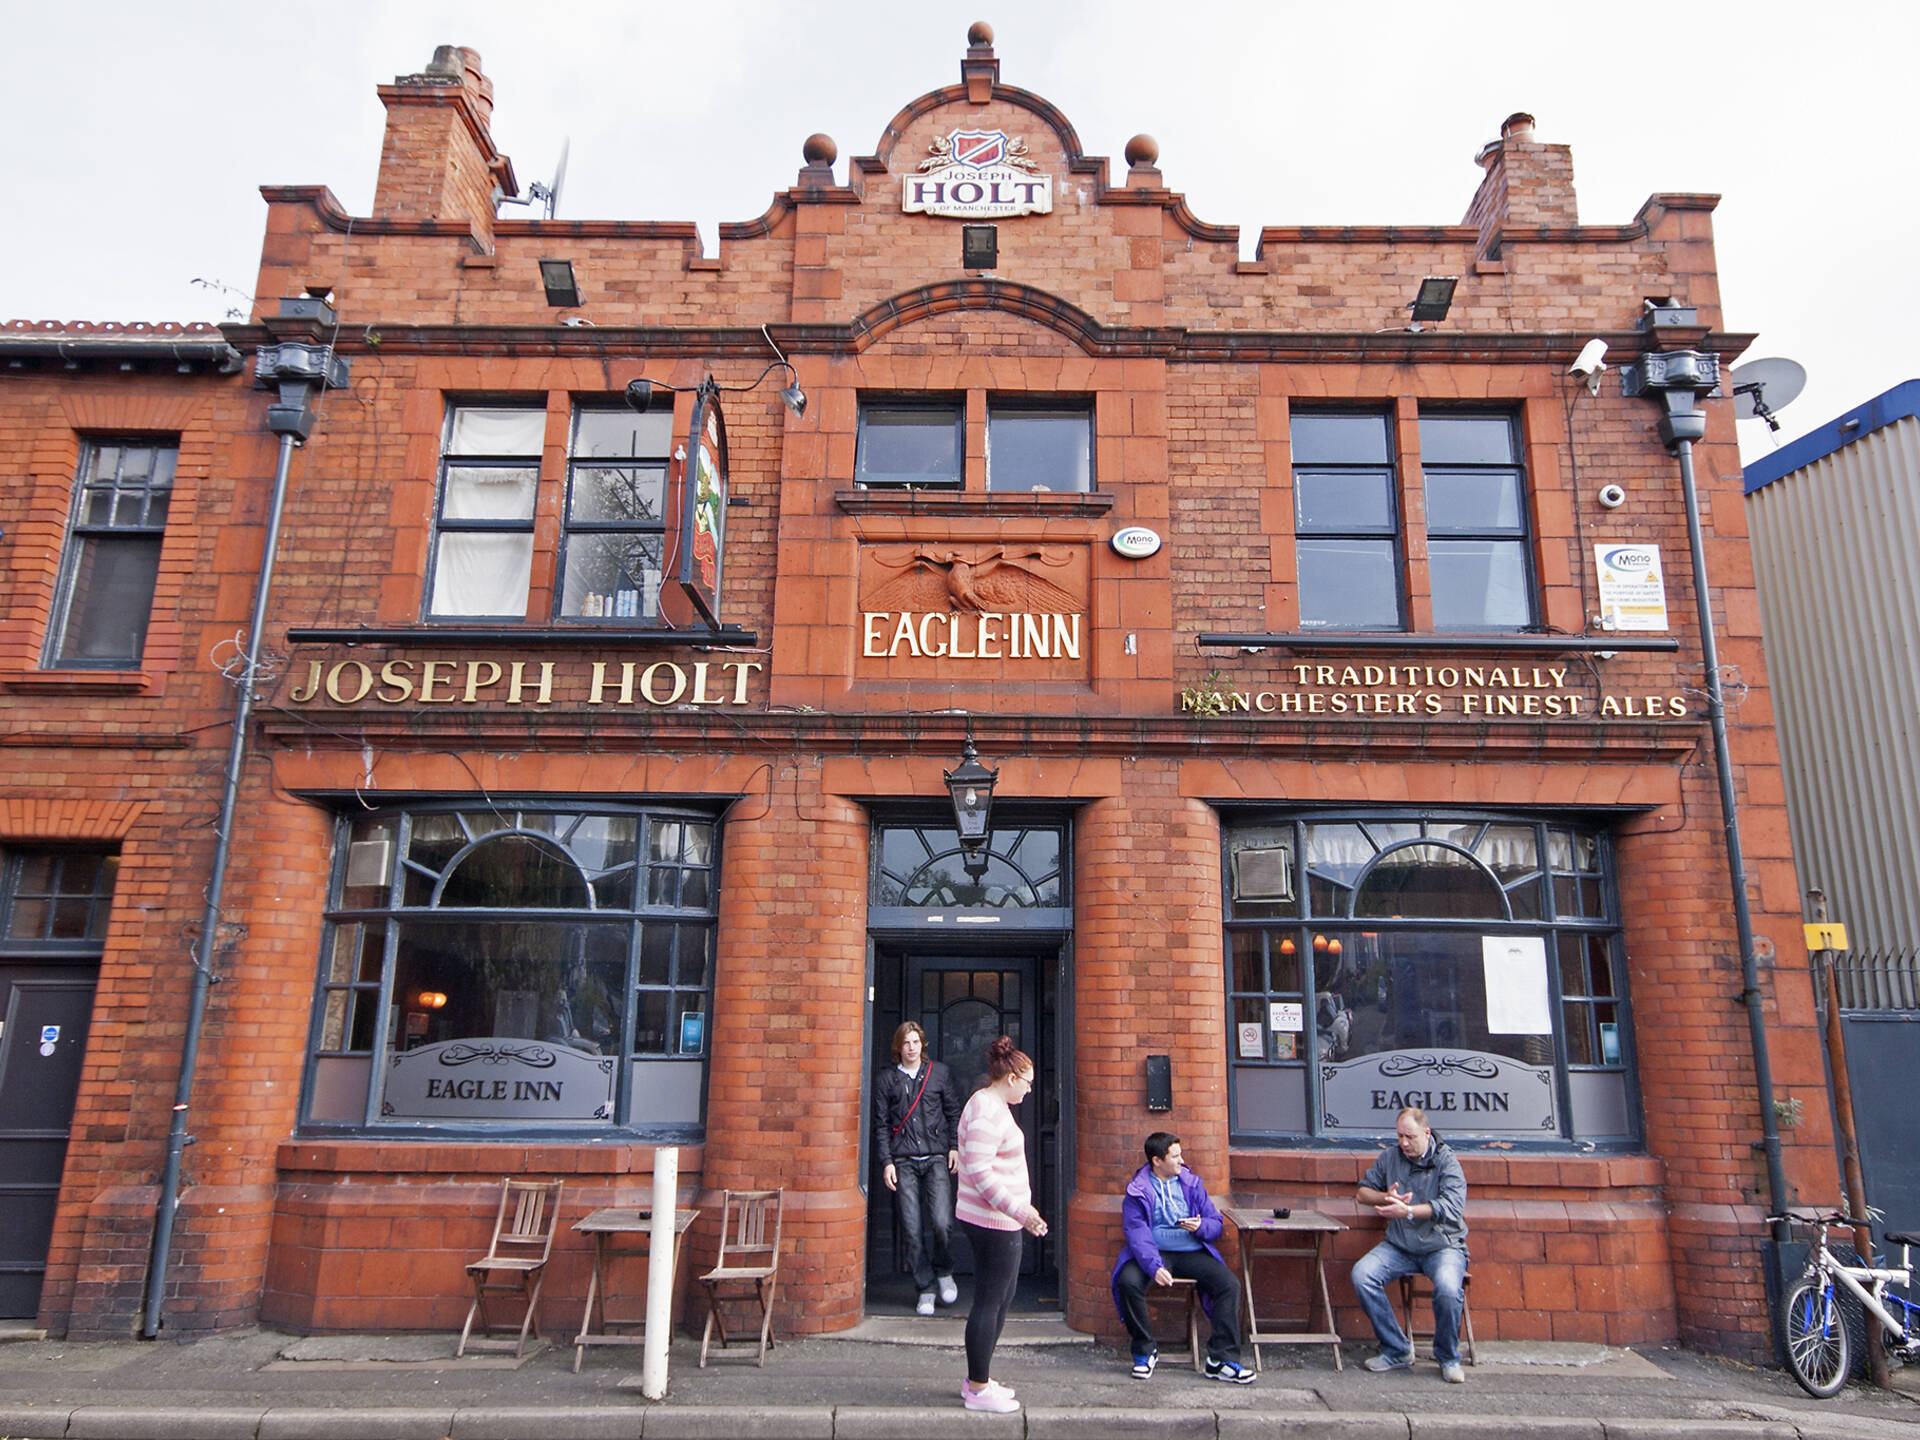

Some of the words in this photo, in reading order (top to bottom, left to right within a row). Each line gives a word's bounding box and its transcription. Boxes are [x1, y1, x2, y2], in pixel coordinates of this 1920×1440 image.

[944, 171, 1012, 181] JOSEPH
[913, 182, 1045, 204] HOLT
[289, 659, 555, 705] JOSEPH
[587, 661, 763, 706] HOLT
[1293, 664, 1568, 688] TRADITIONALLY
[1463, 694, 1583, 716] FINEST
[1600, 695, 1687, 718] ALES
[426, 1078, 507, 1101] EAGLE
[513, 1080, 564, 1102] INN
[1371, 1089, 1458, 1112] EAGLE
[1463, 1091, 1510, 1112] INN
